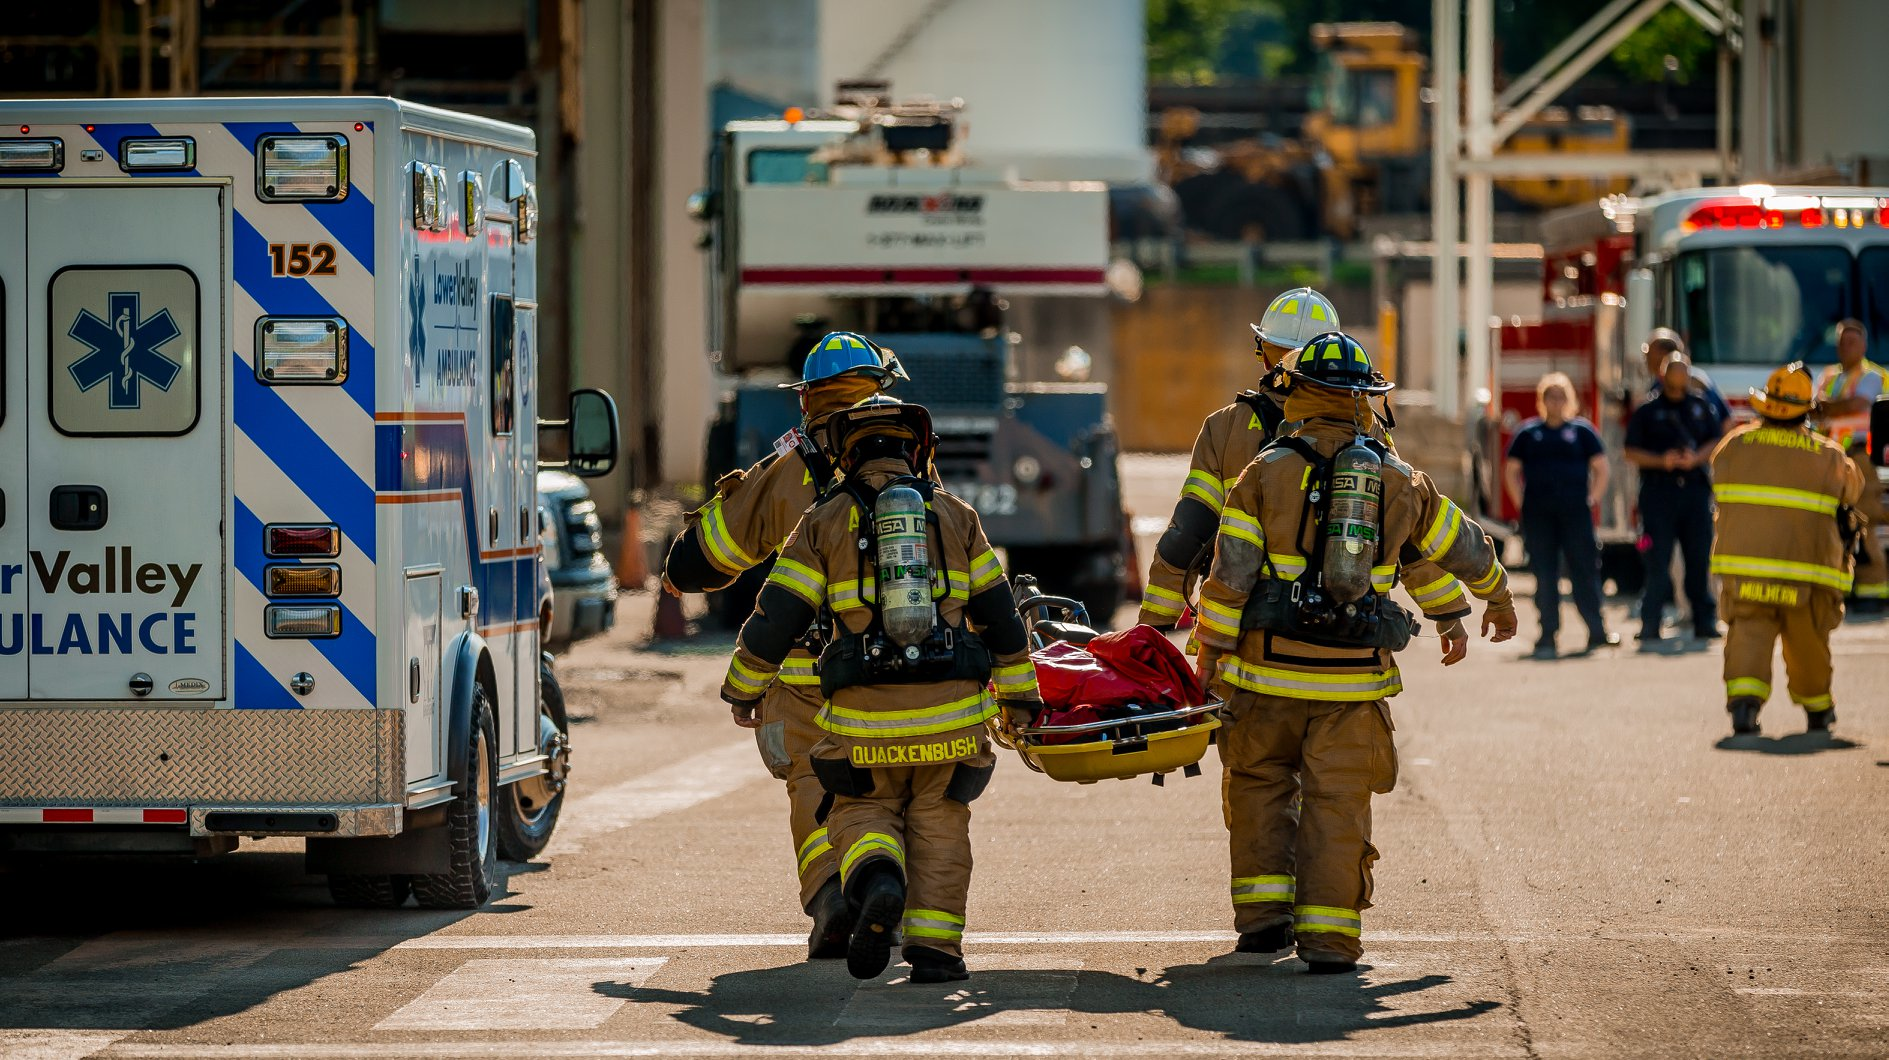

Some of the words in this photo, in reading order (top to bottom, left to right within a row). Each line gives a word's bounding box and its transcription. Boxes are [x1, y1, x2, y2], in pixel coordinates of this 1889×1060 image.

[268, 242, 338, 277] 152
[437, 348, 476, 386] AMBULANCE
[1743, 428, 1823, 454] SPRINGDALE
[29, 546, 203, 607] Valley
[0, 612, 197, 655] ULANCE
[852, 735, 978, 764] QUACKENBUSH
